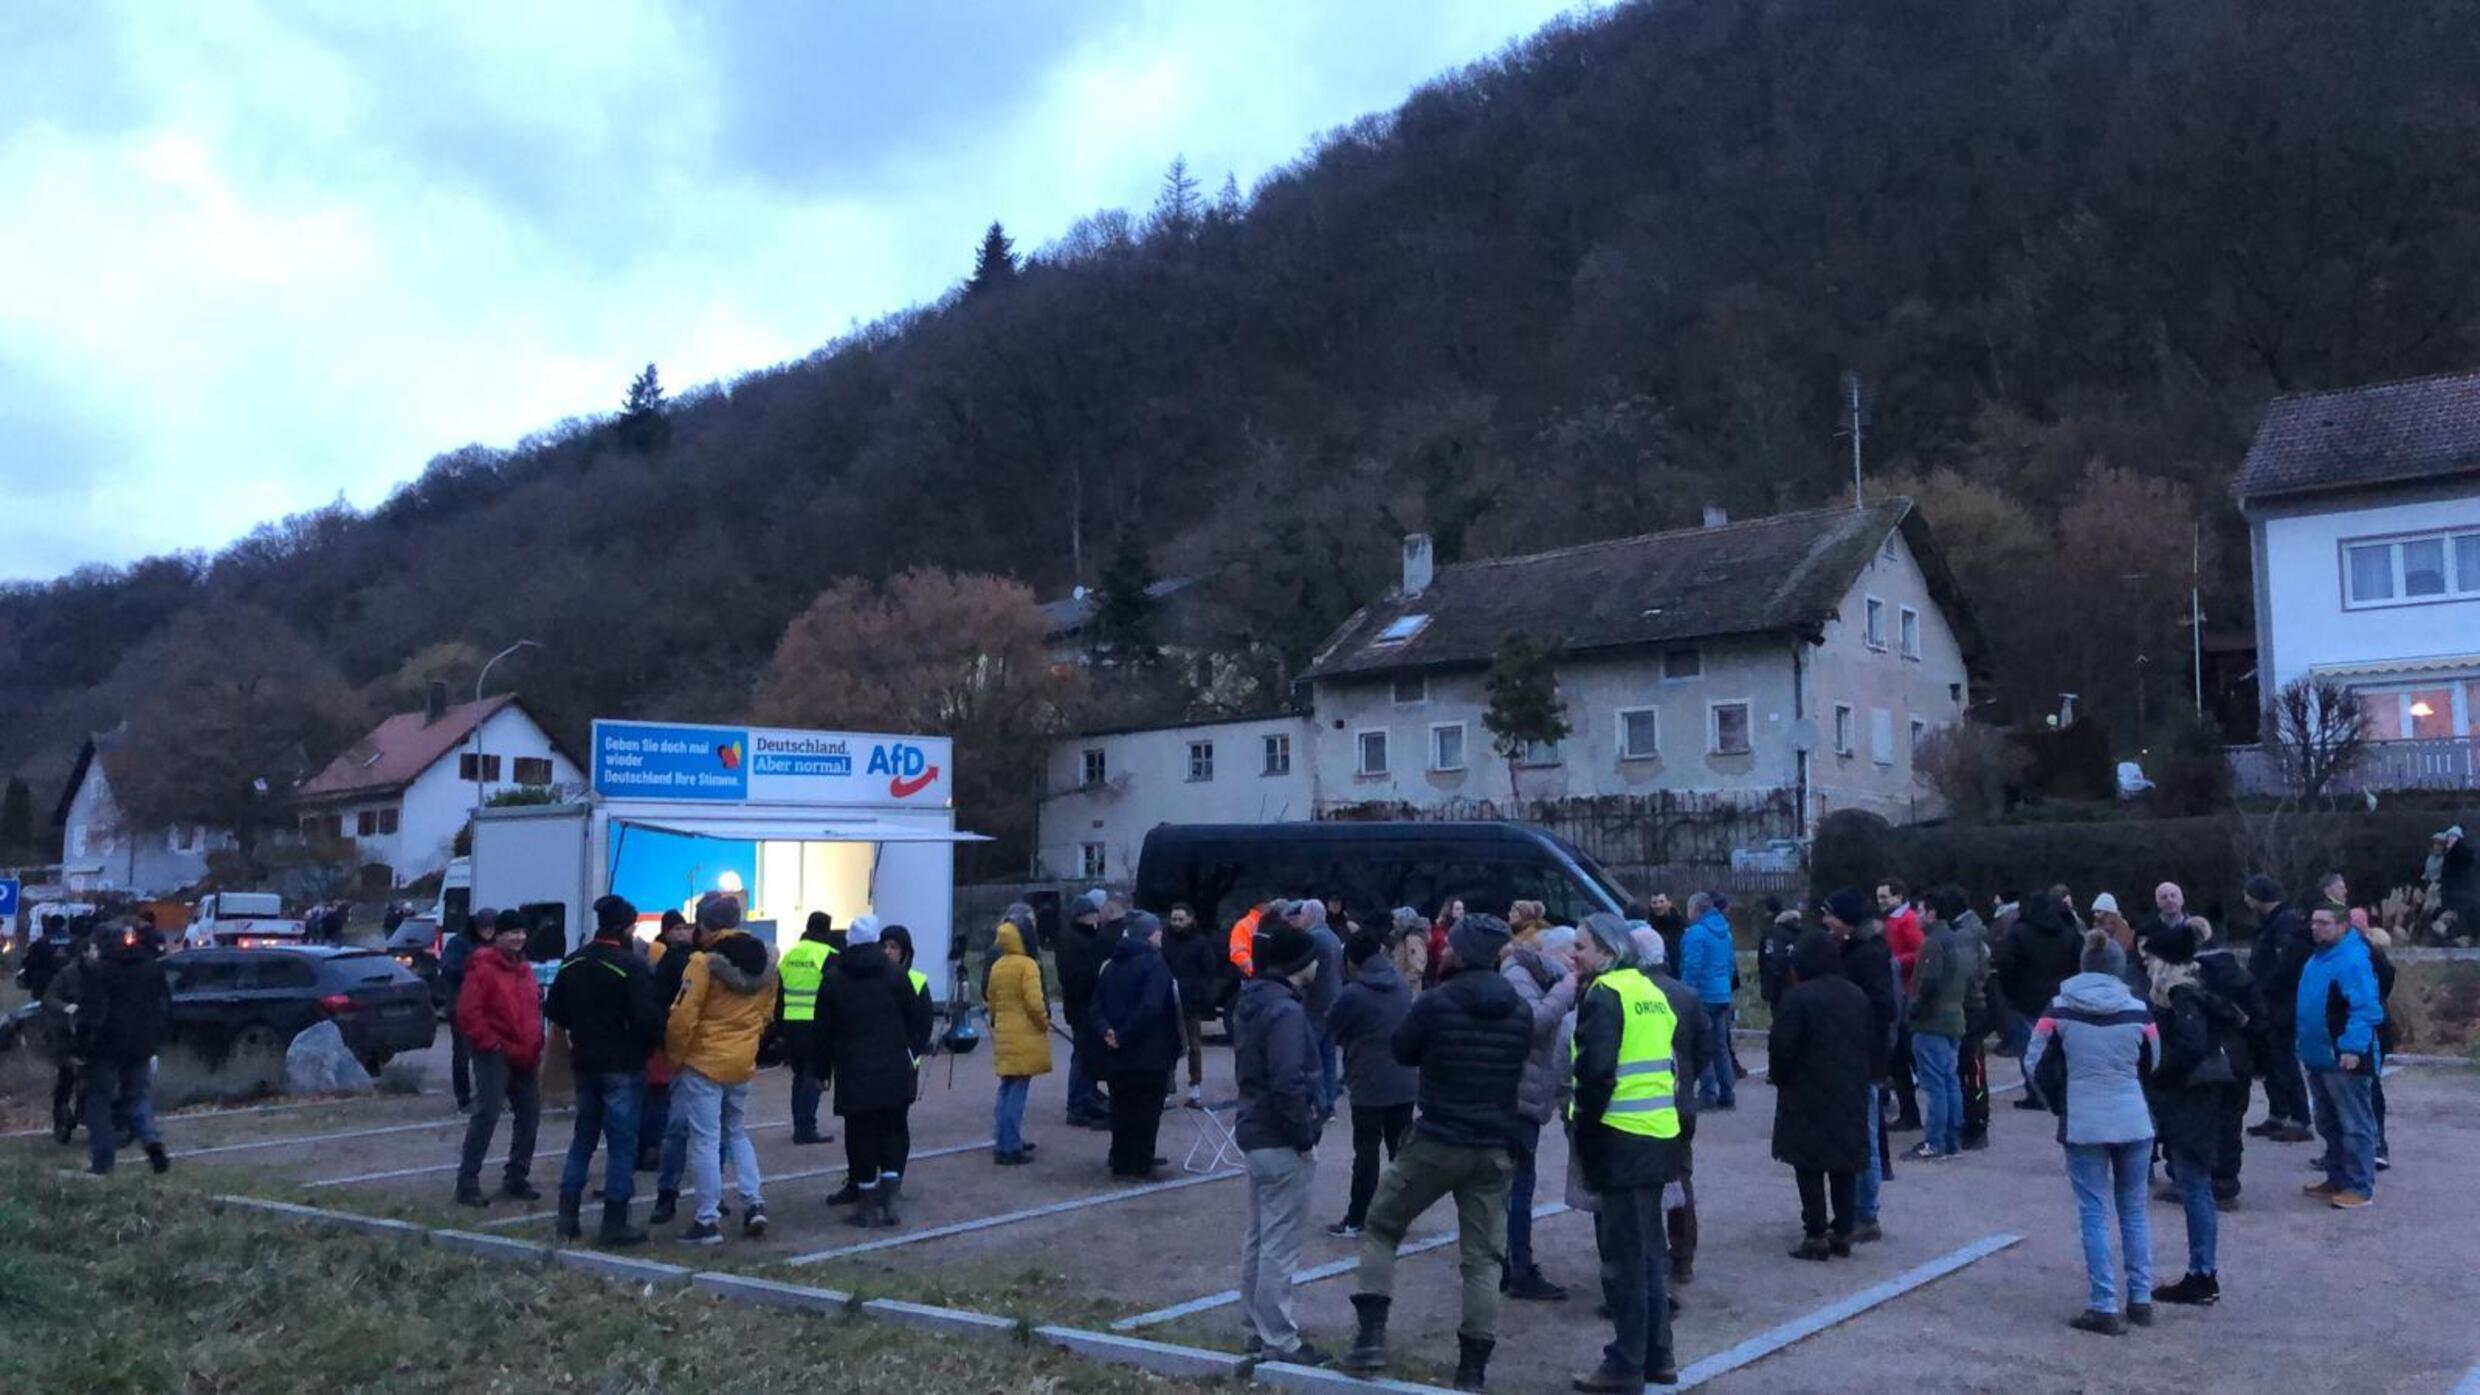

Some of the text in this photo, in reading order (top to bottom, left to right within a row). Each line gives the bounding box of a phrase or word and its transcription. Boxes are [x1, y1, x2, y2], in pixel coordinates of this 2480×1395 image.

[605, 736, 710, 755] Geben Sie doch mal
[756, 737, 849, 755] Deutschland.
[605, 754, 644, 767] wieder
[756, 757, 849, 774] Aber normal.
[866, 743, 925, 776] AfD
[604, 770, 672, 785] Deutschland
[675, 772, 696, 787] Ihre
